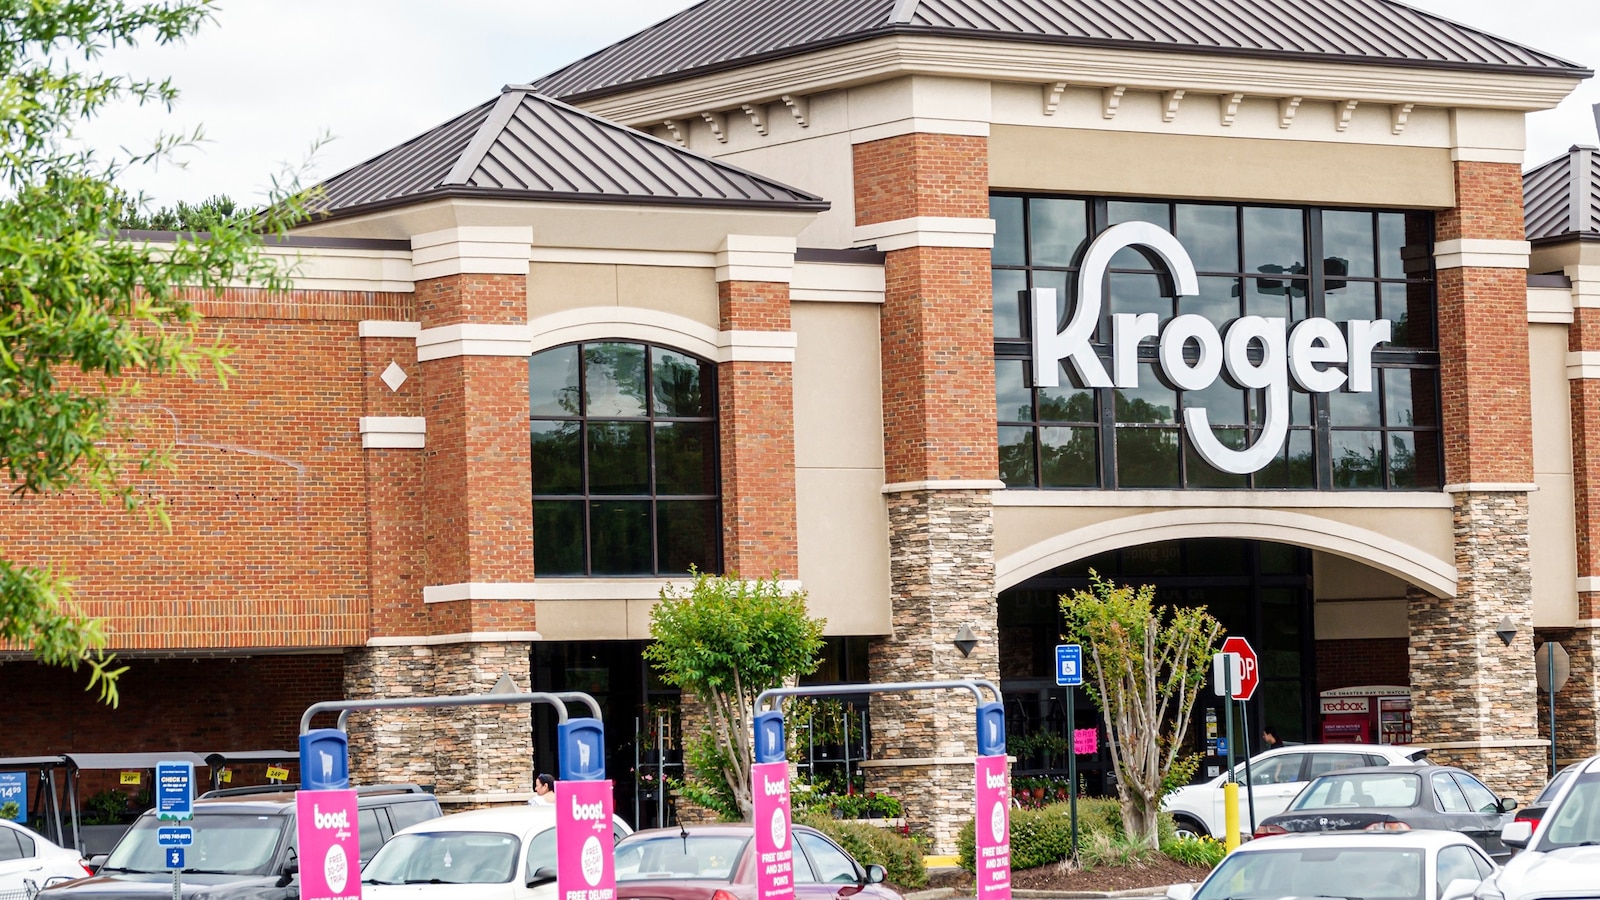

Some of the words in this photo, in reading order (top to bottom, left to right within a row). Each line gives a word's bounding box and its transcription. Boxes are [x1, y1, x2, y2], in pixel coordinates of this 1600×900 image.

[1031, 221, 1391, 474] Kroger
[1240, 657, 1255, 680] OP
[0, 786, 21, 798] 1499
[585, 845, 599, 856] FREE
[171, 853, 180, 864] 3
[328, 853, 342, 864] FREE
[766, 864, 777, 874] AND
[773, 875, 788, 886] POINTS
